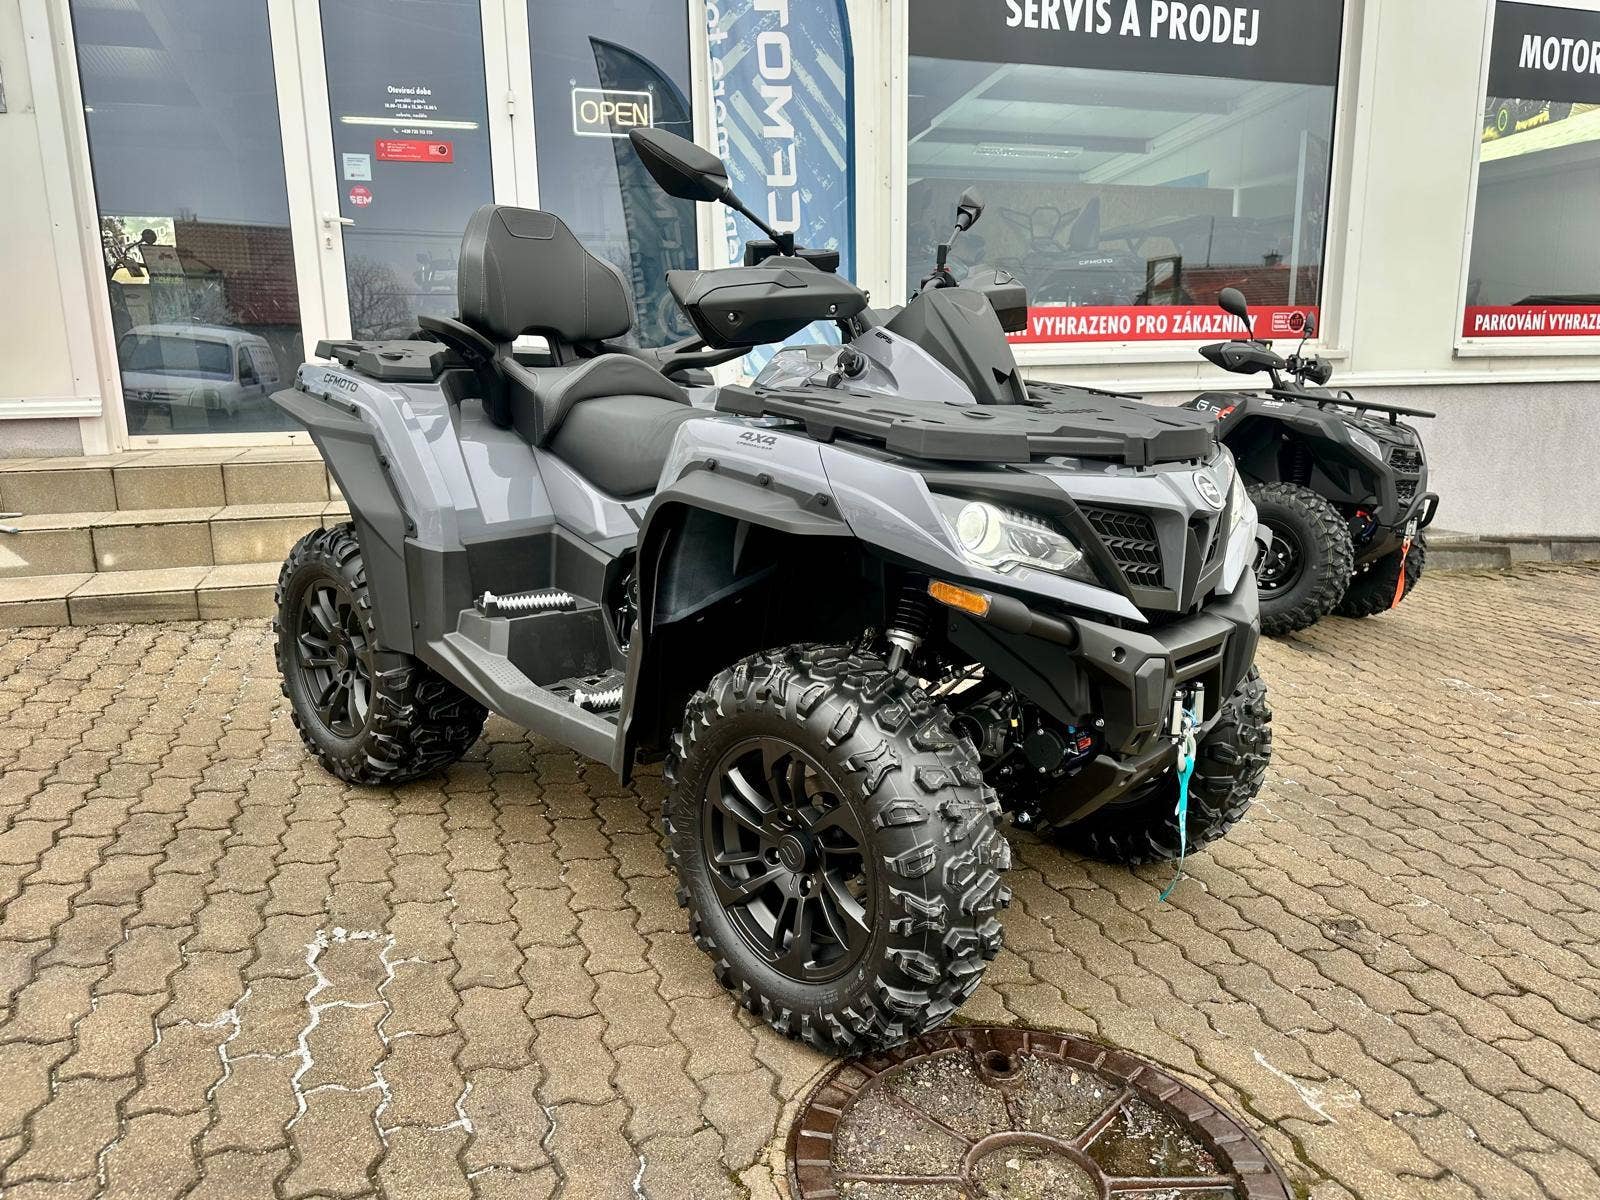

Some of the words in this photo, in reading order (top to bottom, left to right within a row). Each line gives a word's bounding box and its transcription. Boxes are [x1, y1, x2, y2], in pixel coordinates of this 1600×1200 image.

[1006, 0, 1112, 35] SERVIS
[1119, 0, 1141, 37] A
[1150, 1, 1260, 47] PRODEJ
[1519, 34, 1600, 75] MOTOR
[580, 100, 648, 126] OPEN
[1032, 315, 1136, 336] VYHRAZENO
[1139, 315, 1169, 334] PRO
[1474, 310, 1548, 331] PARKOVÁNÍ
[874, 332, 894, 345] EPS
[323, 373, 359, 393] CFMOTO
